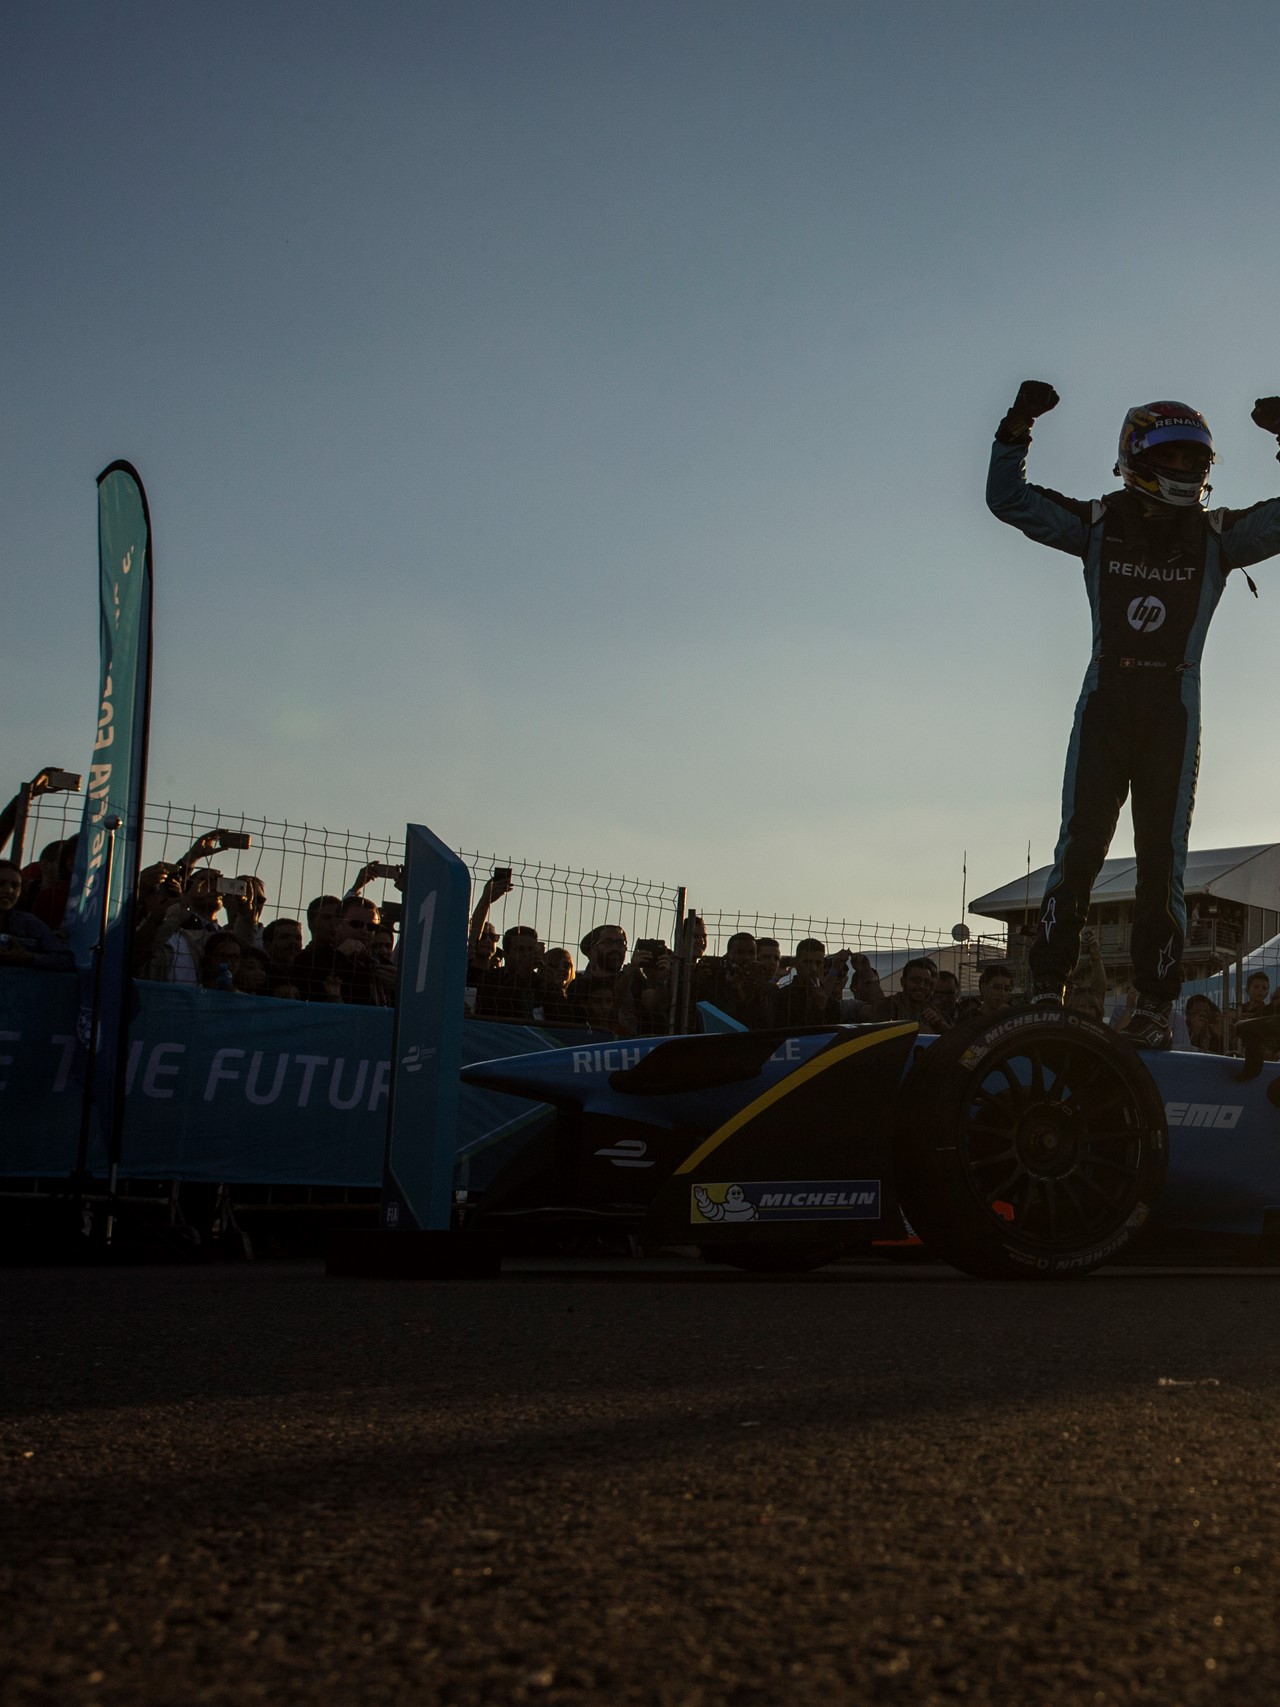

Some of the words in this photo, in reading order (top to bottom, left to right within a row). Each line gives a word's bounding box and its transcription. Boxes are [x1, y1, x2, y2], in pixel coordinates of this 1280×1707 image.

[1108, 561, 1196, 581] RENAULT
[1129, 596, 1164, 633] hp
[415, 890, 437, 993] 1
[985, 1012, 1061, 1044] MICHELIN
[573, 1047, 642, 1073] RICH
[203, 1048, 392, 1111] FUTUR
[759, 1192, 876, 1207] MICHELIN
